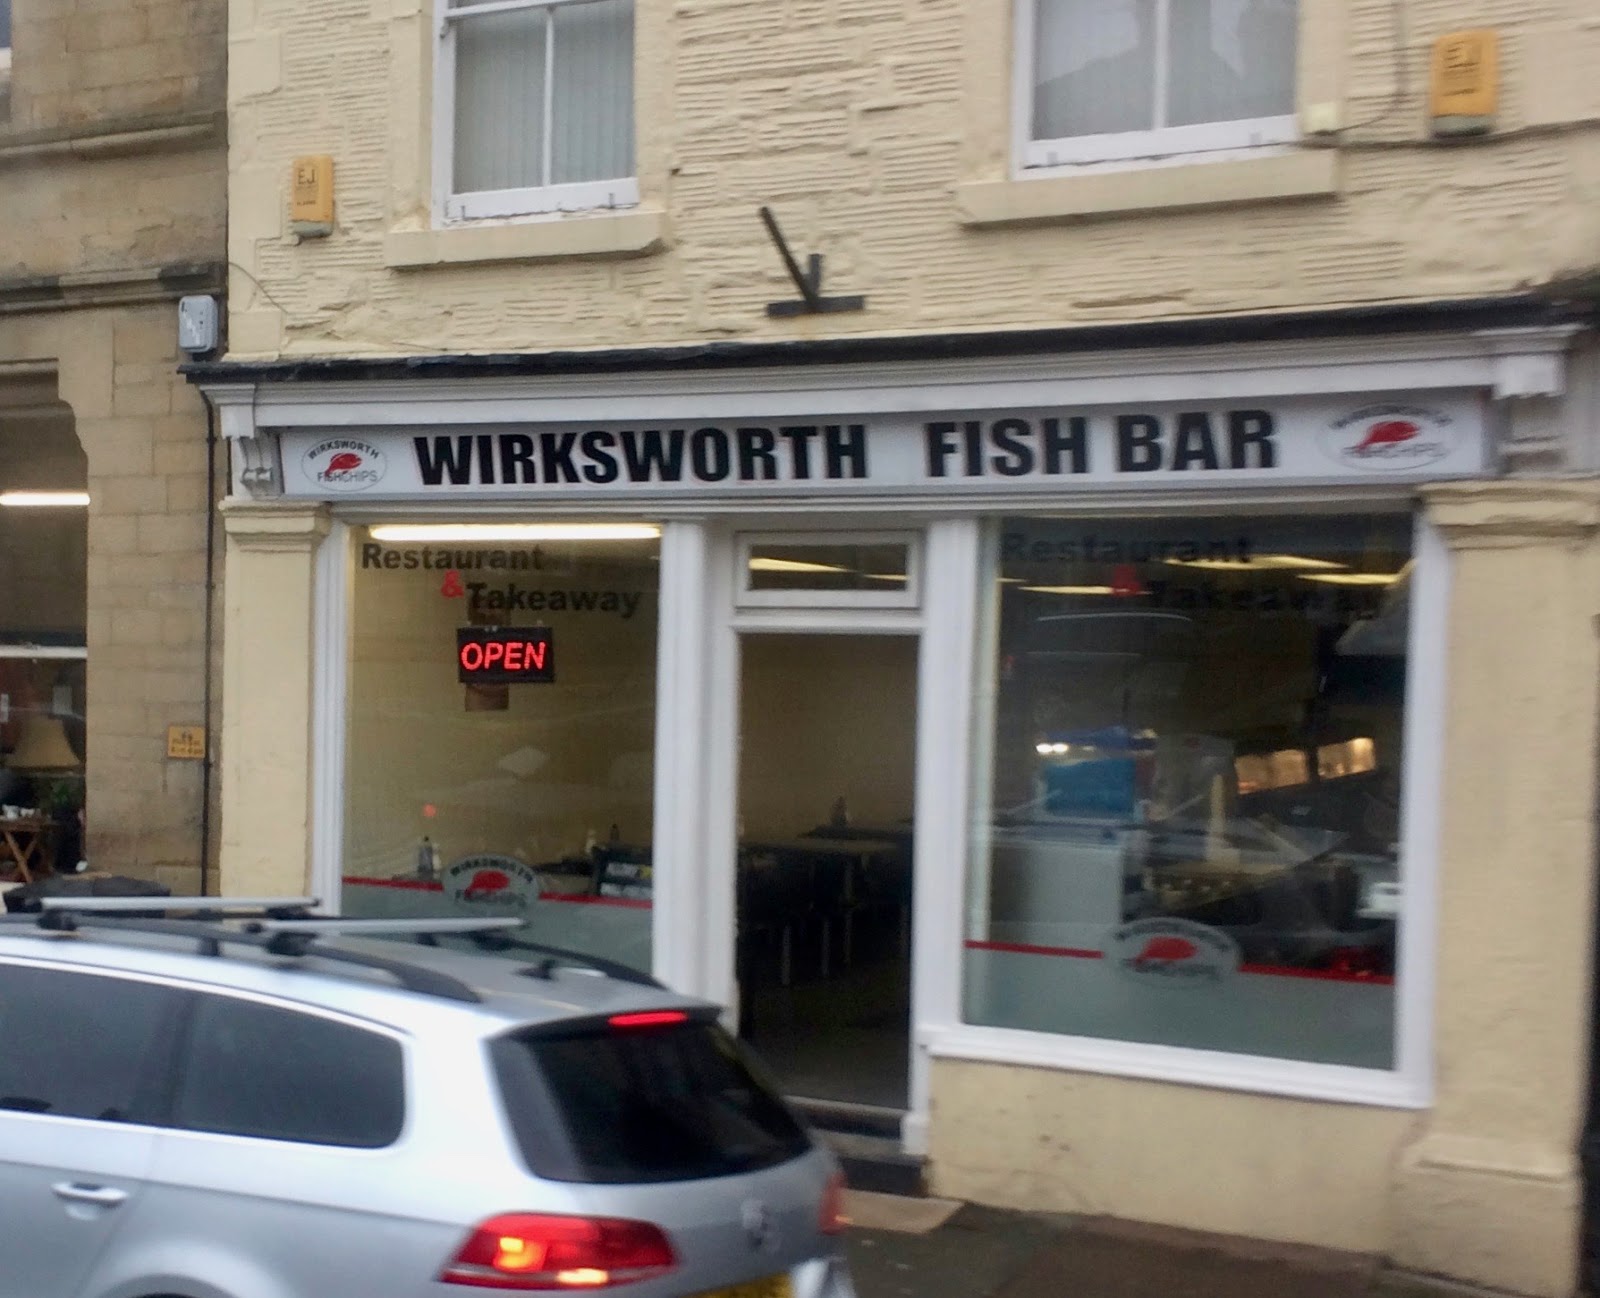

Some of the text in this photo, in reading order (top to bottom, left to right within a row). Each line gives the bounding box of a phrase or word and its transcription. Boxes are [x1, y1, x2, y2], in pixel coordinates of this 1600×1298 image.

[308, 440, 380, 460] WIRKSWORTH
[413, 424, 867, 485] WIRKSWORTH
[926, 416, 1090, 477] FISH
[1115, 409, 1278, 472] BAR
[361, 543, 543, 570] Restaurant
[440, 570, 642, 618] & Takeaway
[460, 642, 546, 670] OPEN
